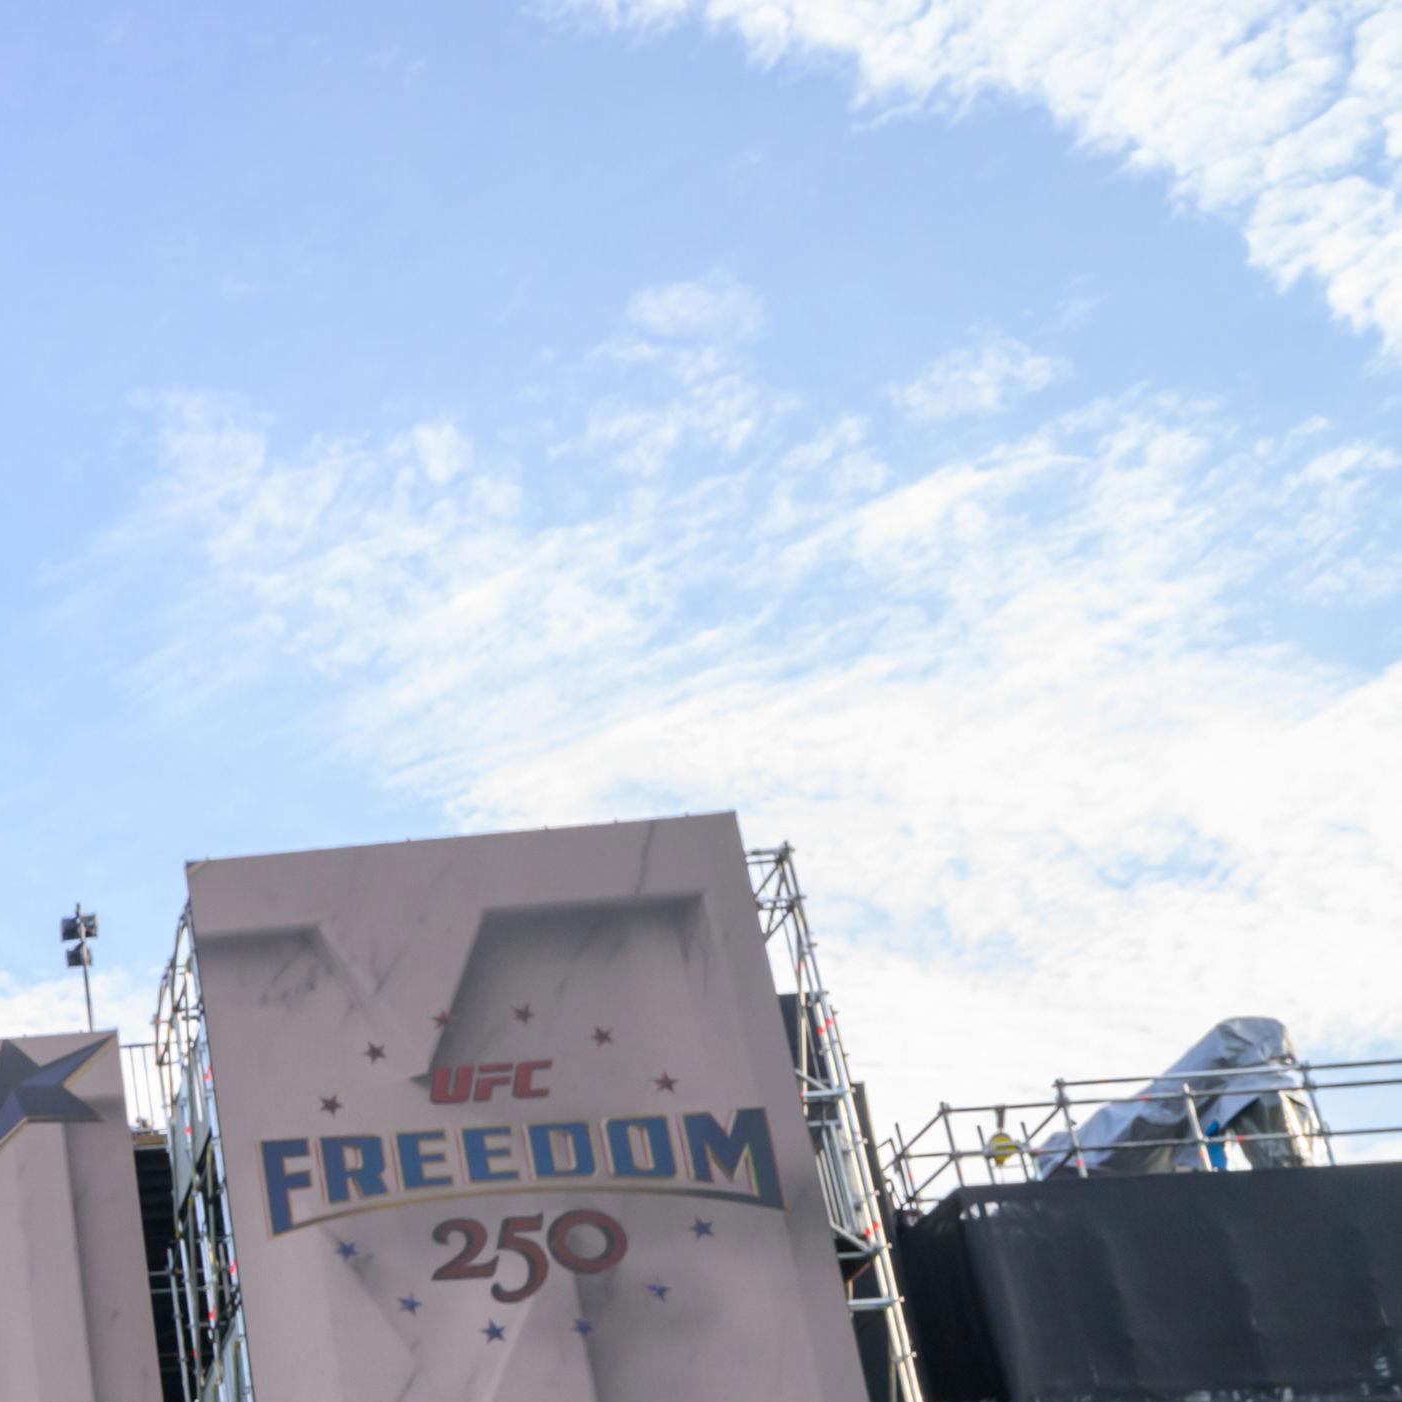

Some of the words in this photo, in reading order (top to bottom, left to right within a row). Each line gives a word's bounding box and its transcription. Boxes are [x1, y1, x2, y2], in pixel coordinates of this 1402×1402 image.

[429, 1060, 553, 1105] UFC
[259, 1107, 788, 1238] FREEDOM
[431, 1210, 628, 1303] 250
